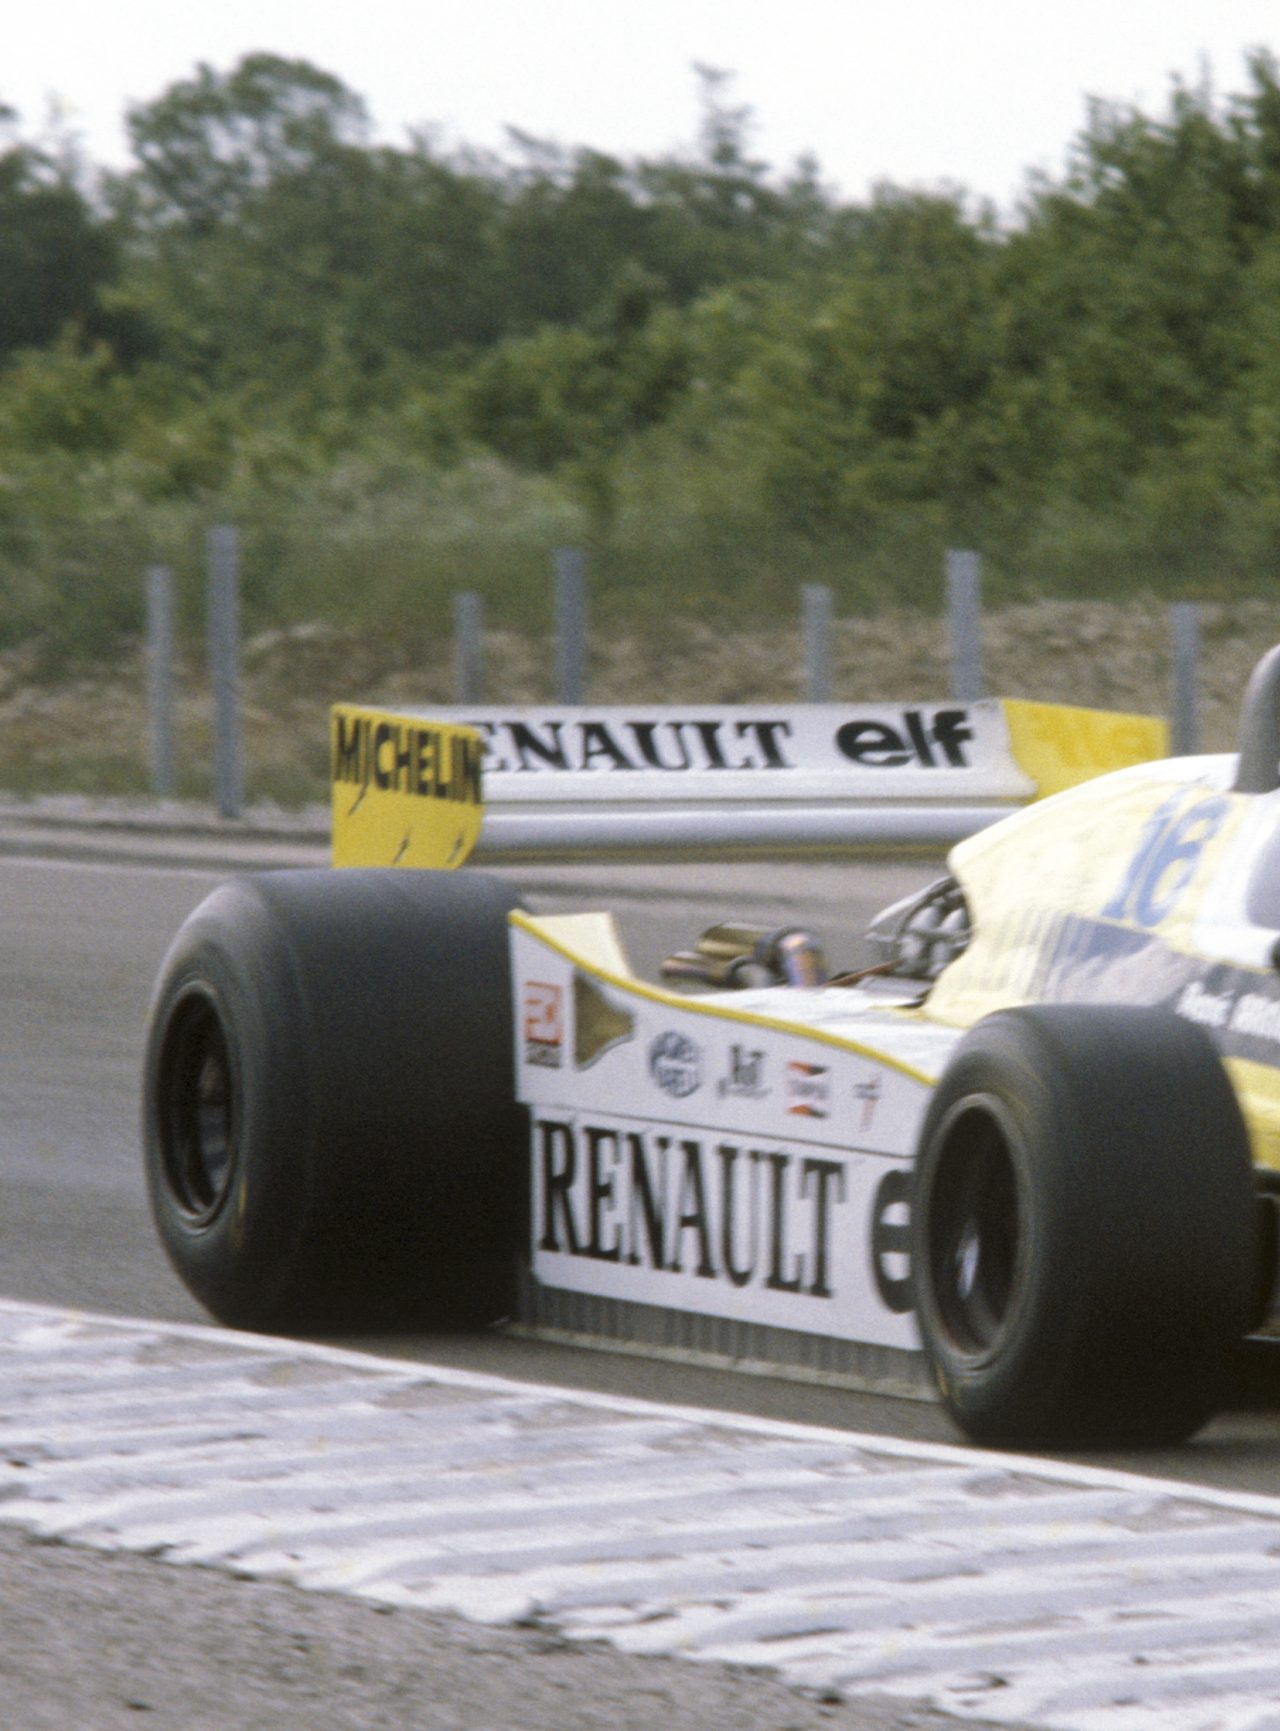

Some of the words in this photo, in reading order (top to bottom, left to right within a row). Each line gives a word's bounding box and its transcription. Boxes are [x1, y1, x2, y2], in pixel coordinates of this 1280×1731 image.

[336, 715, 482, 806] MICHELIN
[835, 709, 974, 769] elf
[1101, 793, 1231, 927] 16
[537, 1119, 848, 1299] RENAULT
